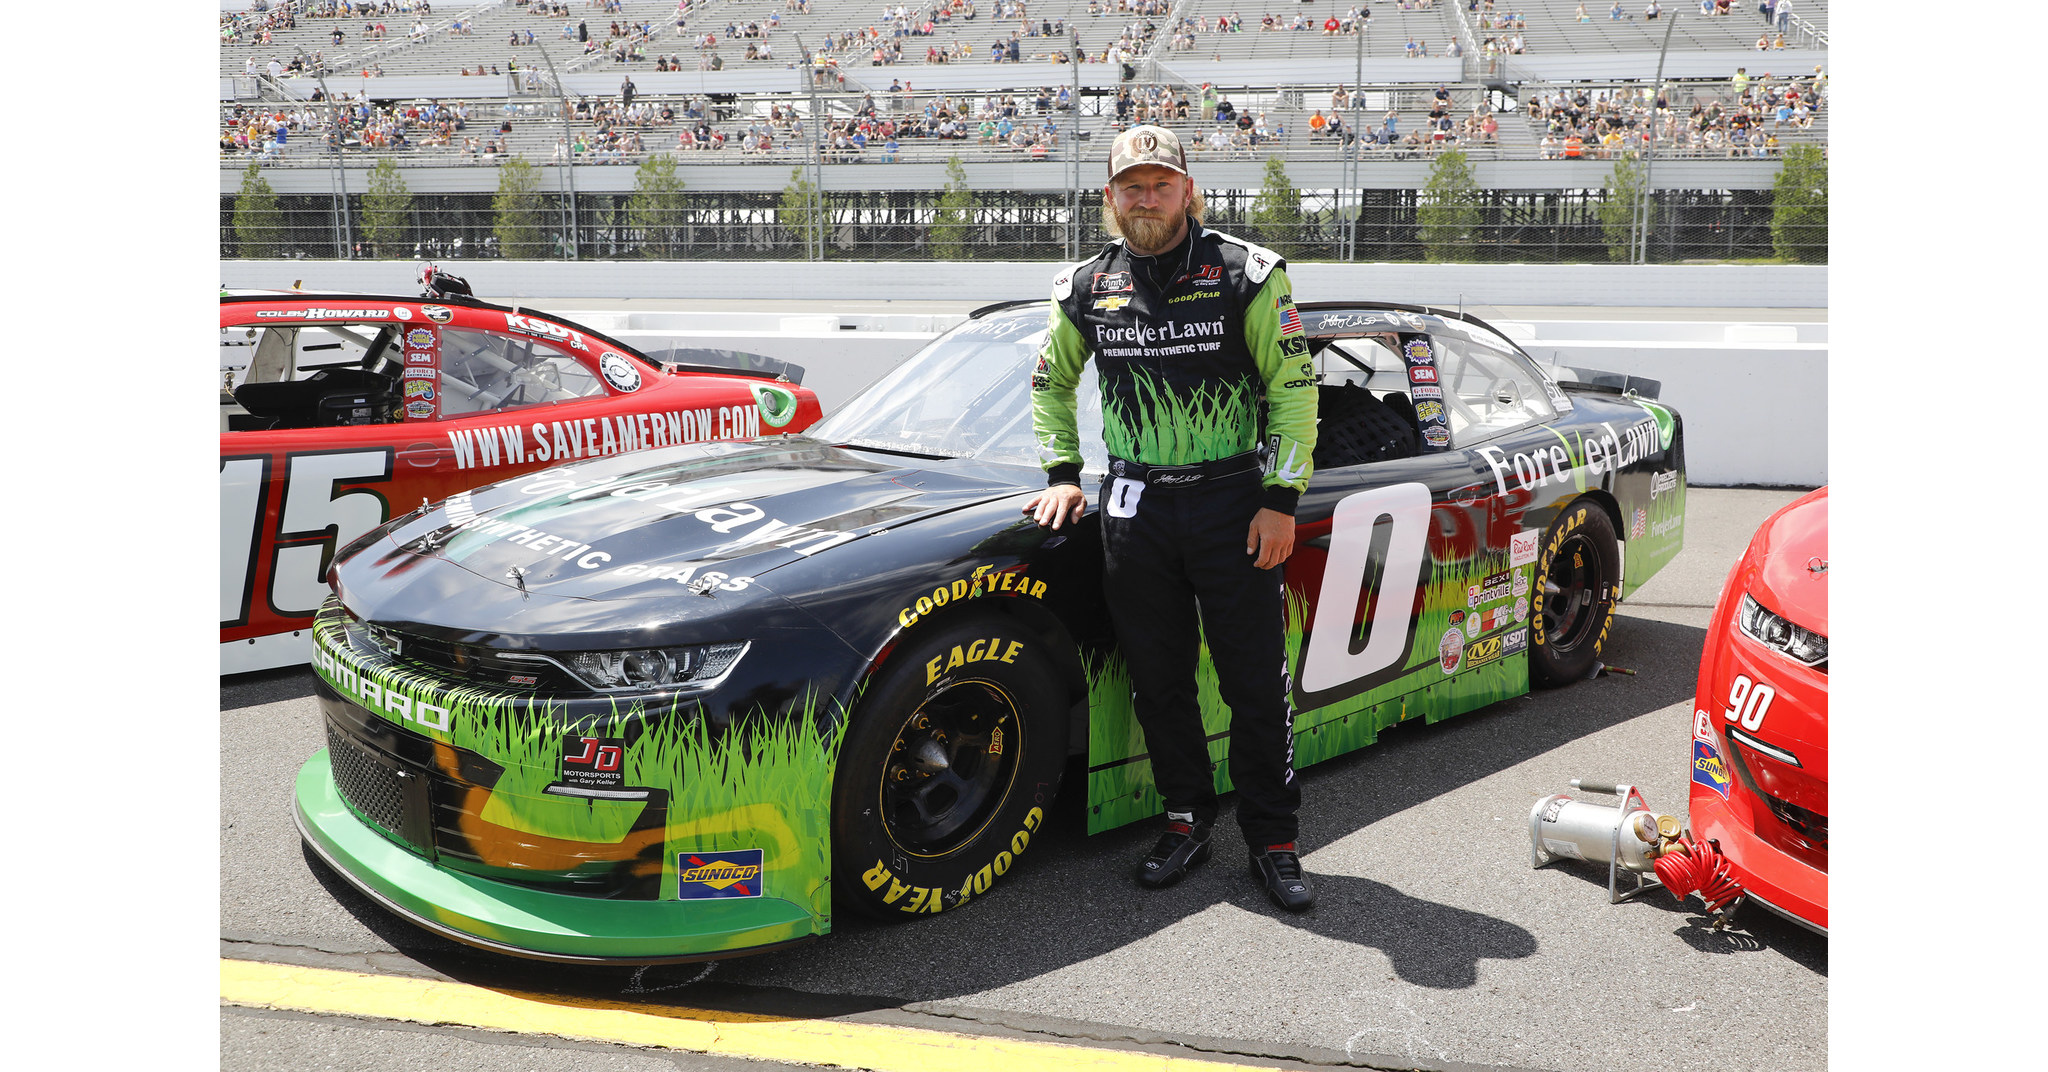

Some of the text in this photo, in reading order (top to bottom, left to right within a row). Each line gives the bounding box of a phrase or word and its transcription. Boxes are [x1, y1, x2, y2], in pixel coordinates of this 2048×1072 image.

[1168, 290, 1221, 304] GOODYEAR
[256, 309, 307, 318] COLBY
[305, 308, 390, 319] HOWARD
[504, 313, 584, 342] KSDT
[570, 340, 589, 352] CPA
[1103, 342, 1221, 357] PREMIUM SYNTHETIC TURF
[410, 353, 431, 362] SEM
[1414, 369, 1435, 380] SEM
[1416, 401, 1443, 412] FLEX
[1418, 408, 1443, 421] SEAL
[448, 404, 761, 470] WWW.SAVEAMERNOW.COM
[1106, 477, 1146, 519] 0
[219, 446, 395, 627] 15
[461, 516, 612, 570] SYNTHETIC
[613, 564, 755, 593] GRASS
[1300, 481, 1433, 694] 0
[1533, 508, 1588, 646] GOODYEAR
[898, 569, 1048, 629] GOODYEAR
[1473, 584, 1511, 609] printville
[1594, 585, 1619, 657] EAGLE
[1503, 628, 1527, 648] KSDT
[926, 638, 1025, 688] EAGLE
[312, 638, 450, 733] CAMARO
[508, 675, 538, 684] SS
[1723, 673, 1777, 734] 90
[993, 731, 1001, 751] AERO
[563, 770, 621, 779] MOTORSPORTS
[579, 777, 596, 786] Gary
[861, 806, 1043, 915] GOODYEAR
[684, 866, 755, 881] SUNOCO
